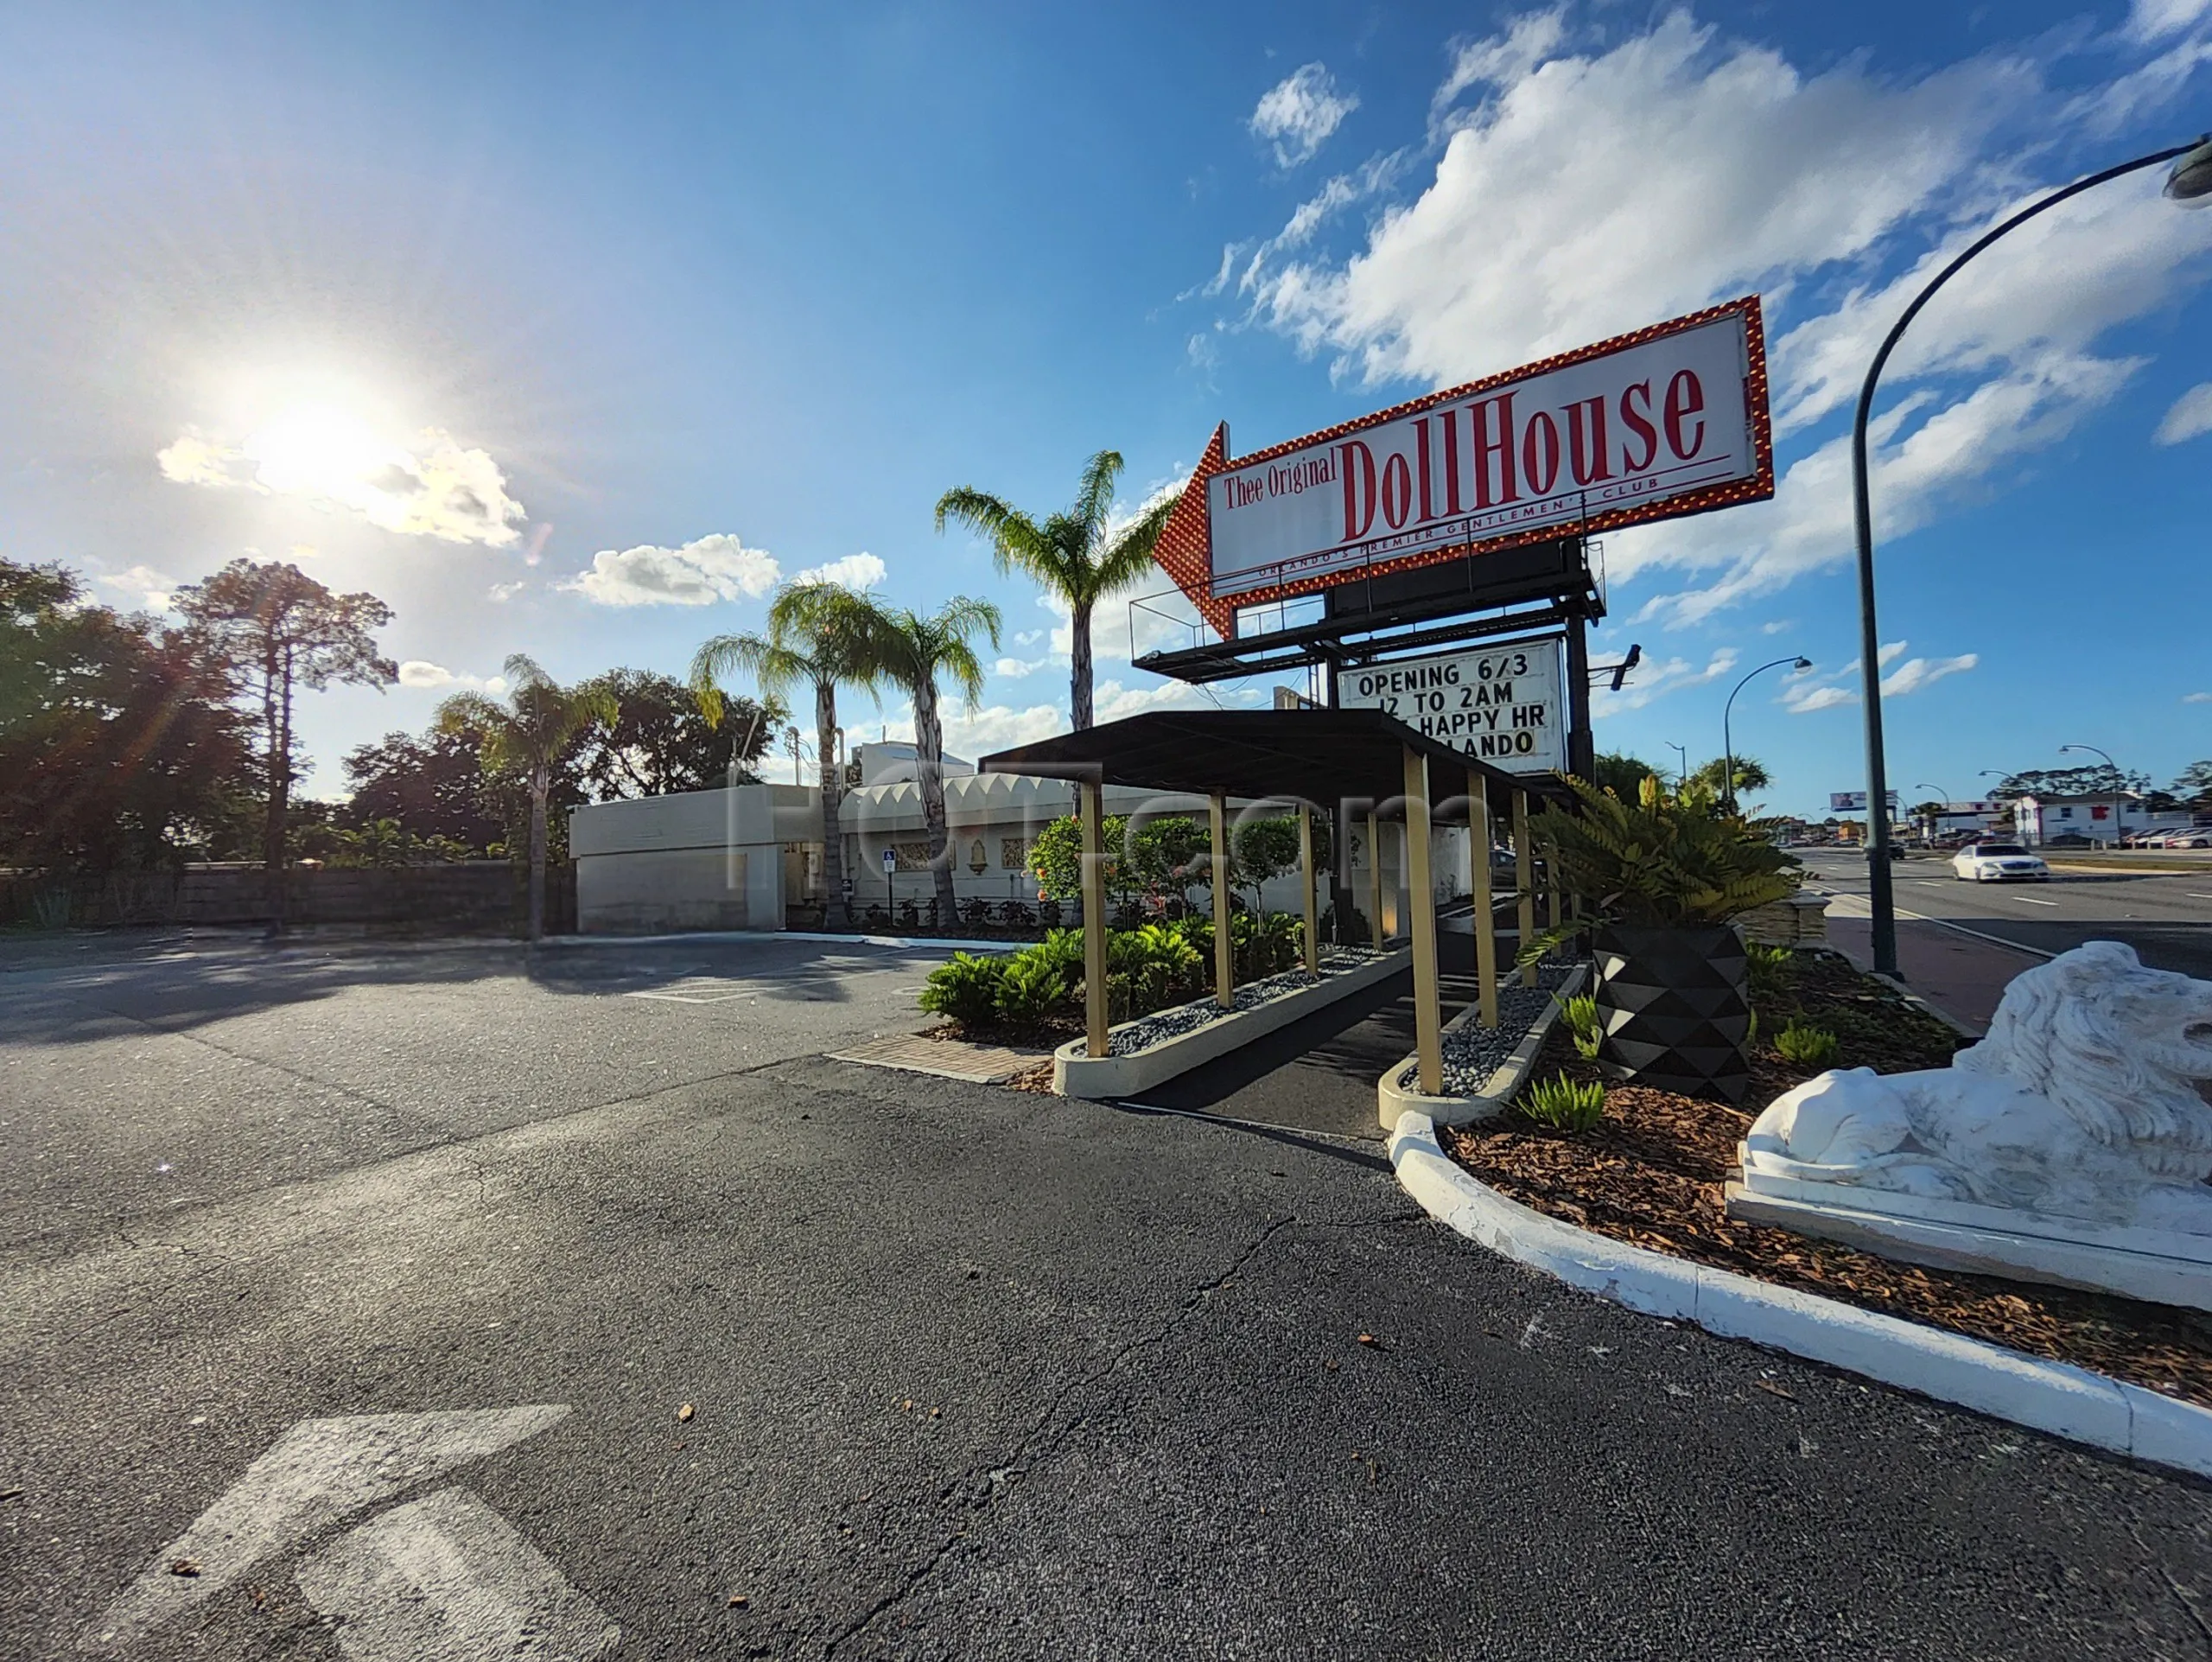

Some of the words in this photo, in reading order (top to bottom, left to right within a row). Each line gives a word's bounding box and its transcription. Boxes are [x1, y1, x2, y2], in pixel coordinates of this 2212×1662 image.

[1224, 475, 1263, 510] Thee
[1267, 446, 1337, 498] Original
[1336, 369, 1705, 544] DollHouse
[1359, 529, 1433, 555] PREMIER
[1602, 478, 1658, 499] CLUB
[1358, 664, 1459, 697] OPENING
[1478, 653, 1529, 680] 6/3
[1413, 691, 1446, 714] TO
[1459, 681, 1512, 709] 2AM
[1420, 707, 1501, 737] HAPPY
[1512, 704, 1545, 729] HR
